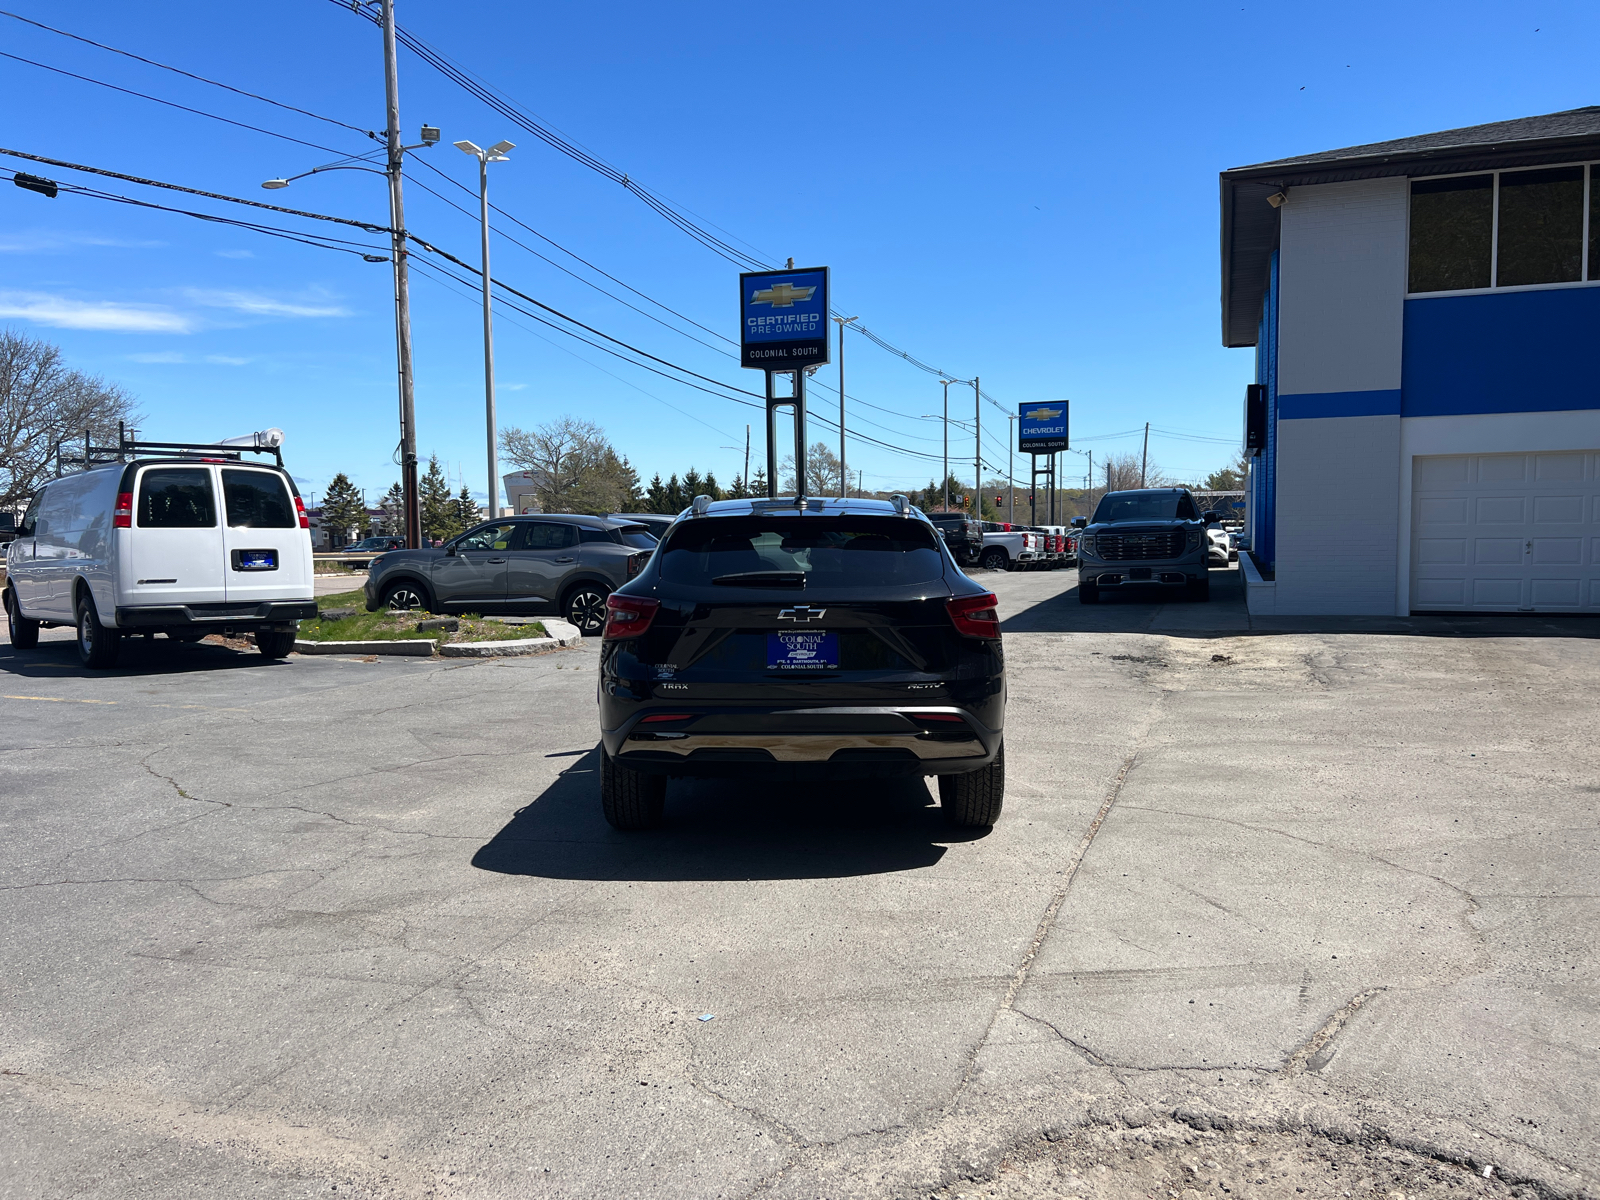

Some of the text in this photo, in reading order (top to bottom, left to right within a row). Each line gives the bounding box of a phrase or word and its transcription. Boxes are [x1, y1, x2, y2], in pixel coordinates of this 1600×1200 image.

[747, 313, 819, 326] CERTIFIED
[751, 322, 816, 334] PRE-OWNED
[749, 347, 818, 358] COLONIAL SOUTH
